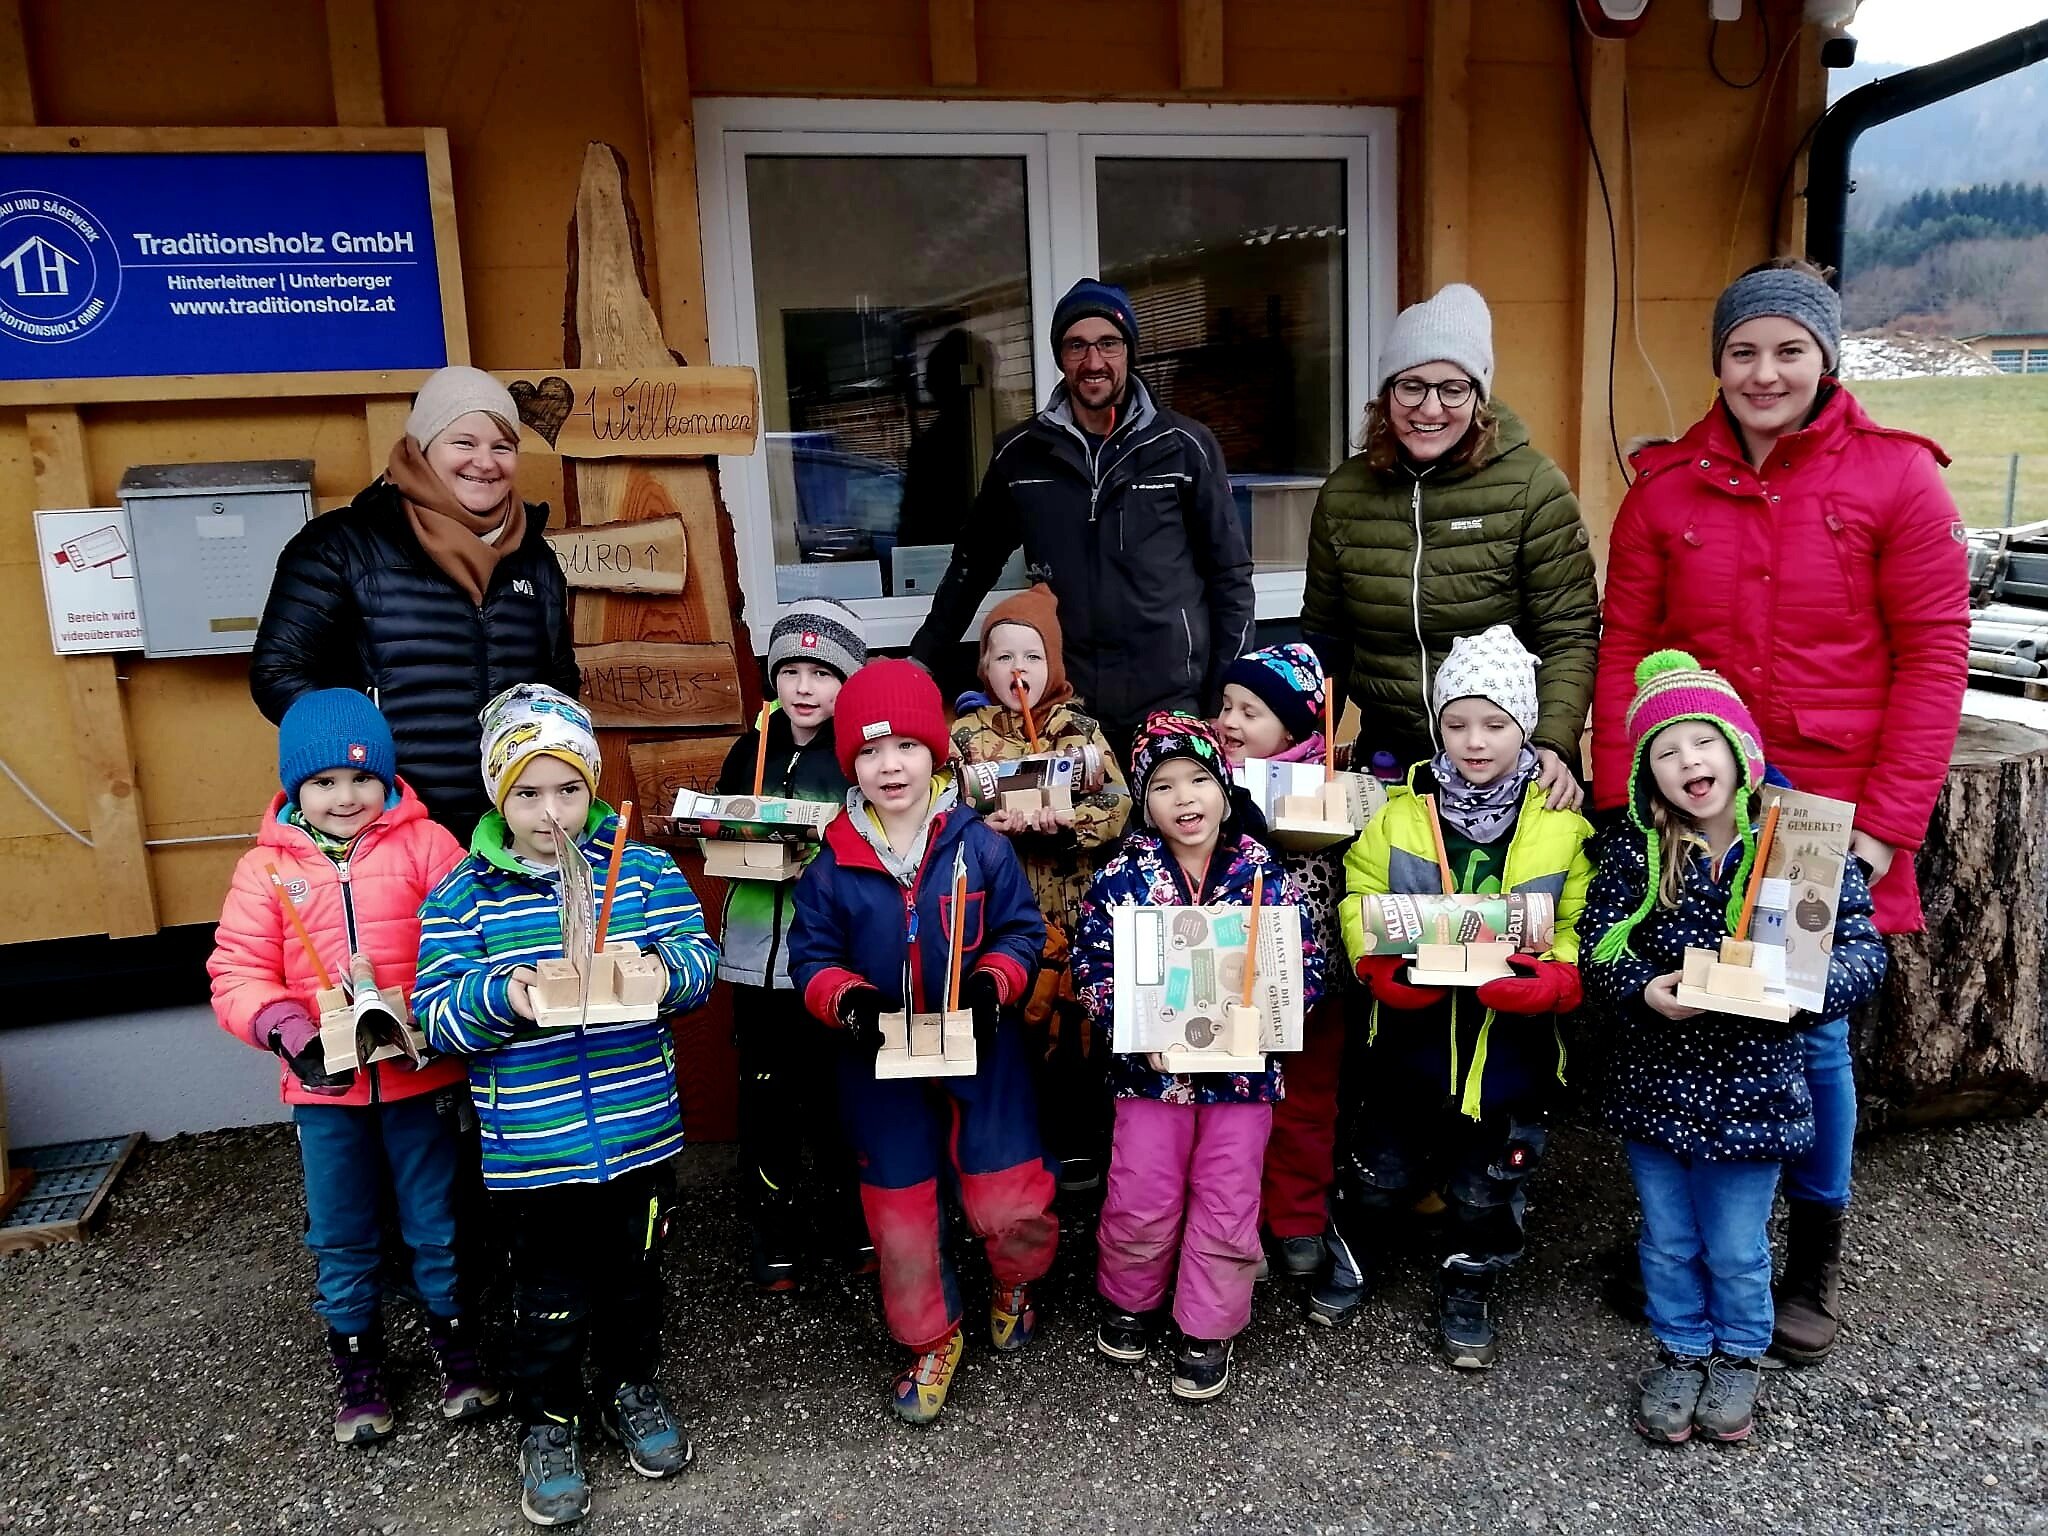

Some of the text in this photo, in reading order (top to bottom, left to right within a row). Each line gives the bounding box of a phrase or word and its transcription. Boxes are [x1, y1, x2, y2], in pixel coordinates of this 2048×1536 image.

[0, 199, 100, 243] AU UND SÄGEWERK
[133, 231, 414, 255] Traditionsholz GmbH
[167, 272, 392, 291] Hinterleitner Unterberger
[0, 297, 105, 337] ADITIONSHOLZ GMBH
[169, 295, 396, 315] www.traditionsholz.at
[585, 378, 751, 441] Willkommen
[67, 609, 136, 623] Bereich wird
[1788, 821, 1842, 832] GEMERKT?
[1789, 866, 1801, 880] 3
[1807, 888, 1814, 899] 6
[1496, 909, 1524, 948] Bau
[1273, 911, 1290, 1006] WAS HAST DU DIR
[1268, 985, 1284, 1044] GEMERKT?
